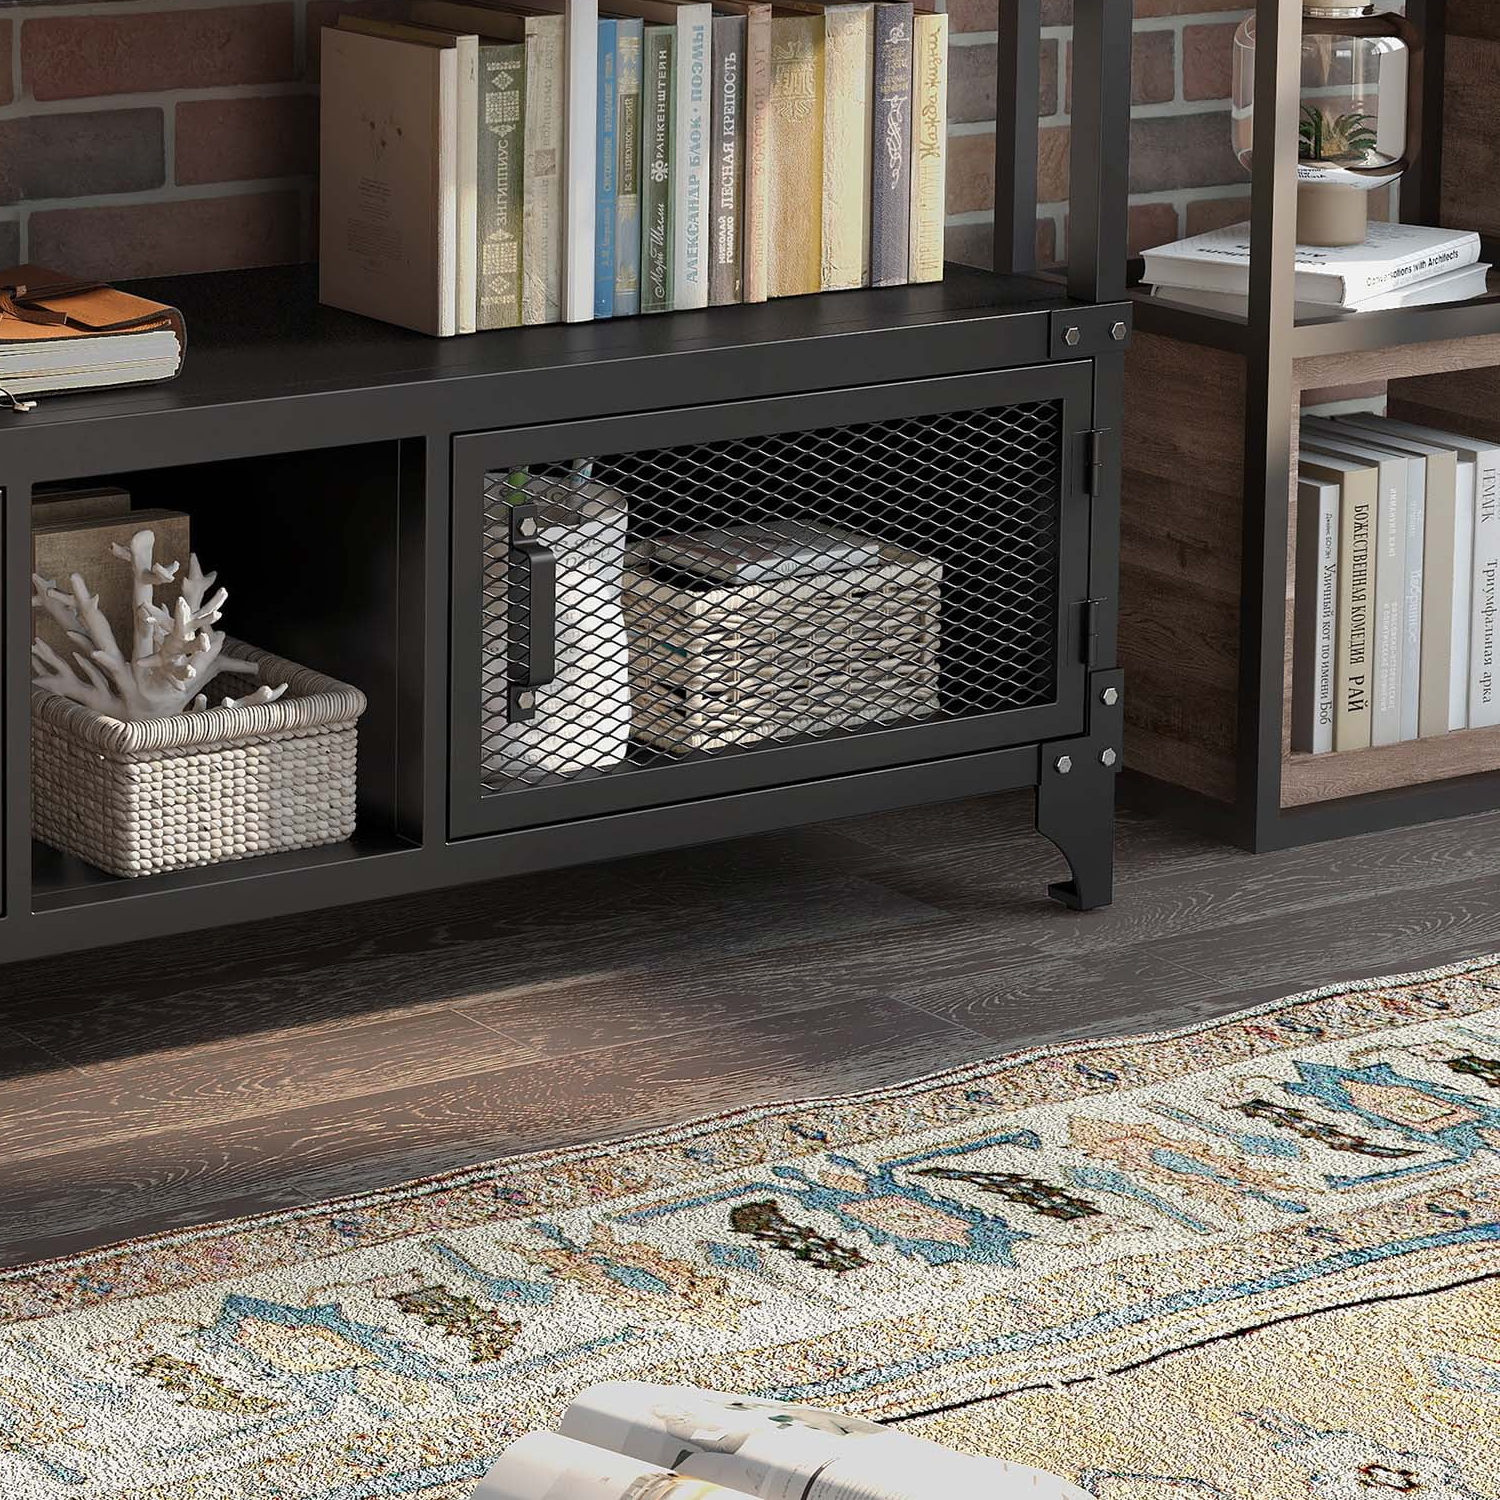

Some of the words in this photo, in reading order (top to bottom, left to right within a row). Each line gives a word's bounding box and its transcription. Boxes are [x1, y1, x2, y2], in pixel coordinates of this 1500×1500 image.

[688, 24, 704, 102] ПОЭМЫ
[922, 27, 944, 88] жизни
[721, 51, 737, 135] КРЕПОСТЬ
[687, 115, 702, 166] БЛОК
[919, 92, 942, 160] Жажда
[720, 140, 735, 209] ЛЕСНАЯ
[648, 202, 666, 245] Шелли
[684, 175, 701, 283] АЛЕКСАНДР
[716, 215, 727, 263] НИКОЛАЙ
[725, 215, 734, 263] ГОМОЛКО
[650, 249, 666, 297] Мэри
[1365, 262, 1413, 287] Conversations
[1413, 259, 1427, 273] with
[1428, 248, 1459, 267] Architects
[1349, 503, 1369, 602] БОЖЕСТВЕННАЯ
[1321, 563, 1336, 617] Уличный
[1478, 558, 1498, 666] Триумфальная
[1321, 620, 1332, 639] кот
[1321, 644, 1331, 659] по
[1346, 604, 1366, 664] КОМЕДИЯ
[1320, 661, 1331, 699] имени
[1346, 674, 1369, 714] РАЙ
[1479, 671, 1493, 703] арка
[1319, 701, 1332, 725] Боб
